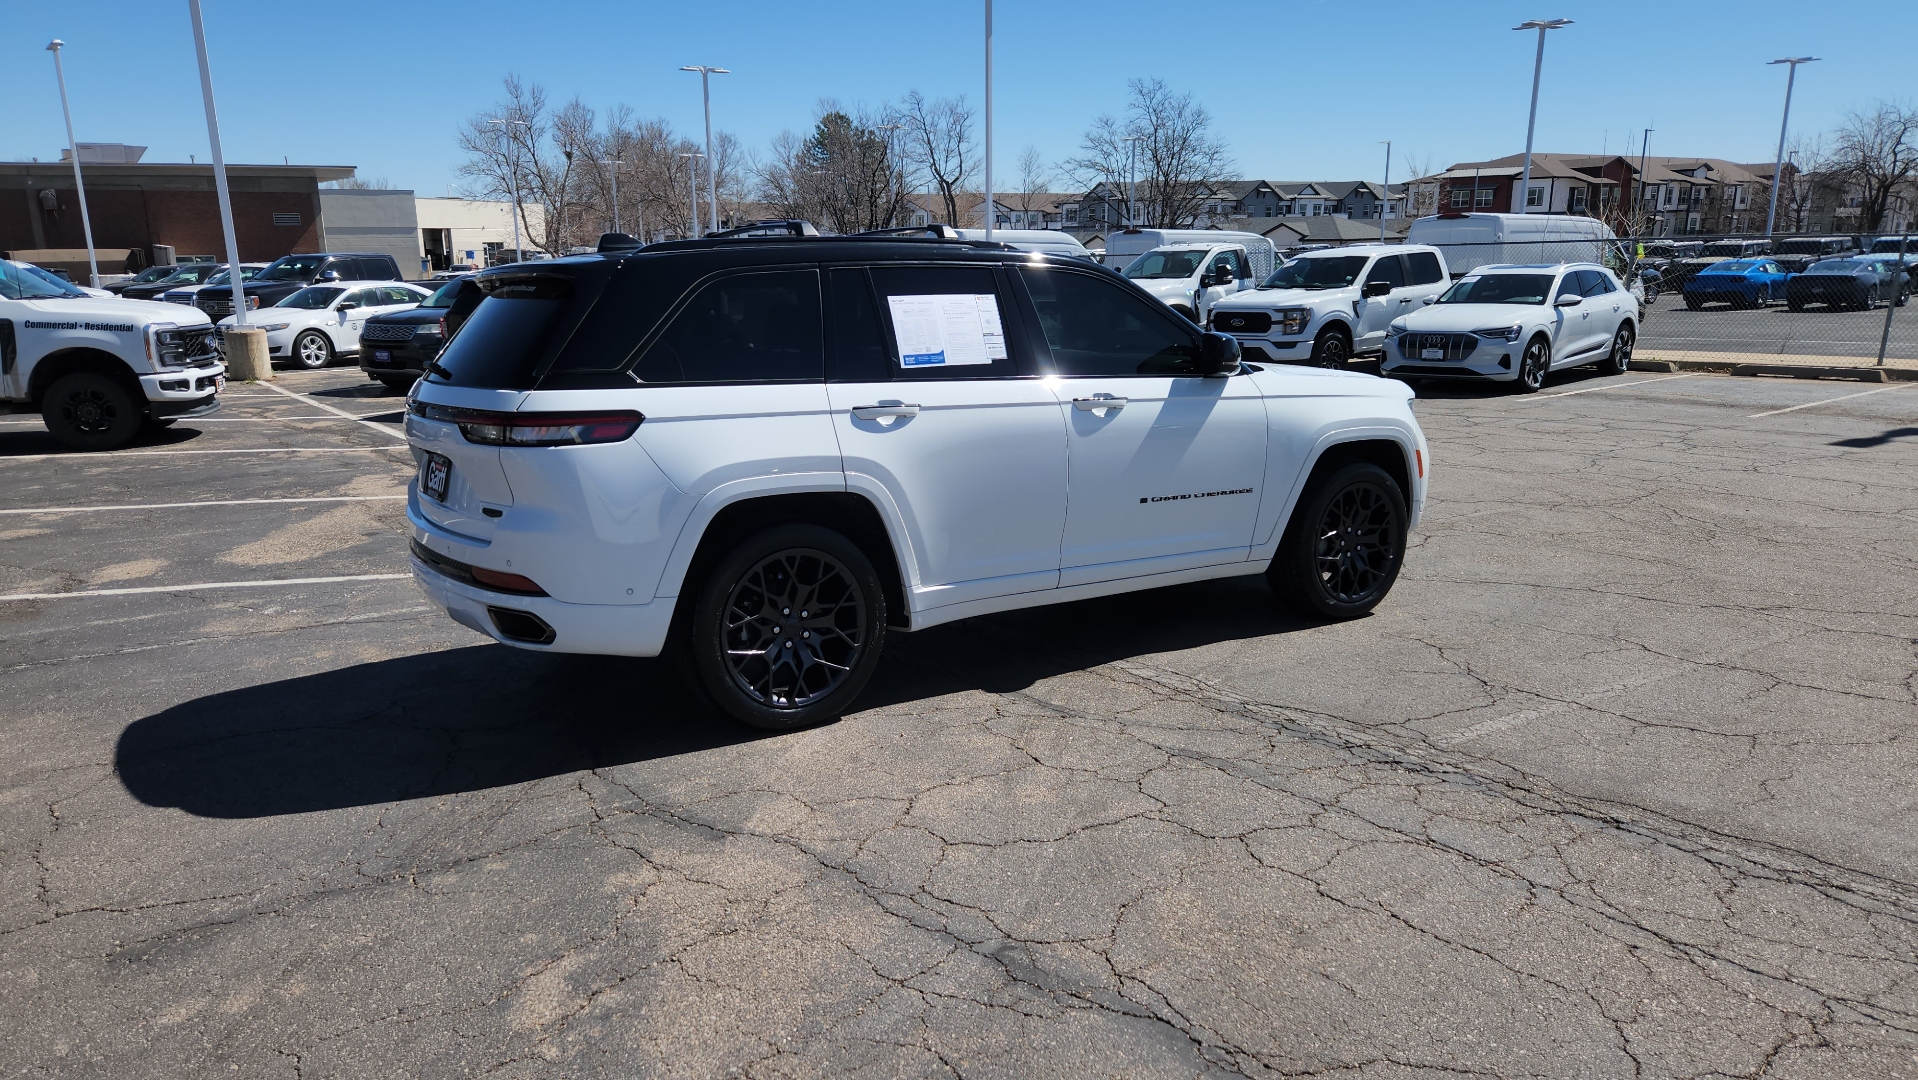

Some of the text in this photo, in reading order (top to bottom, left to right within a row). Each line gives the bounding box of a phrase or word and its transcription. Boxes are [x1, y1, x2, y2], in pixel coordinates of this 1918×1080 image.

[24, 320, 134, 332] Commercial Residential
[1151, 488, 1254, 502] GRAND CHEROKEE
